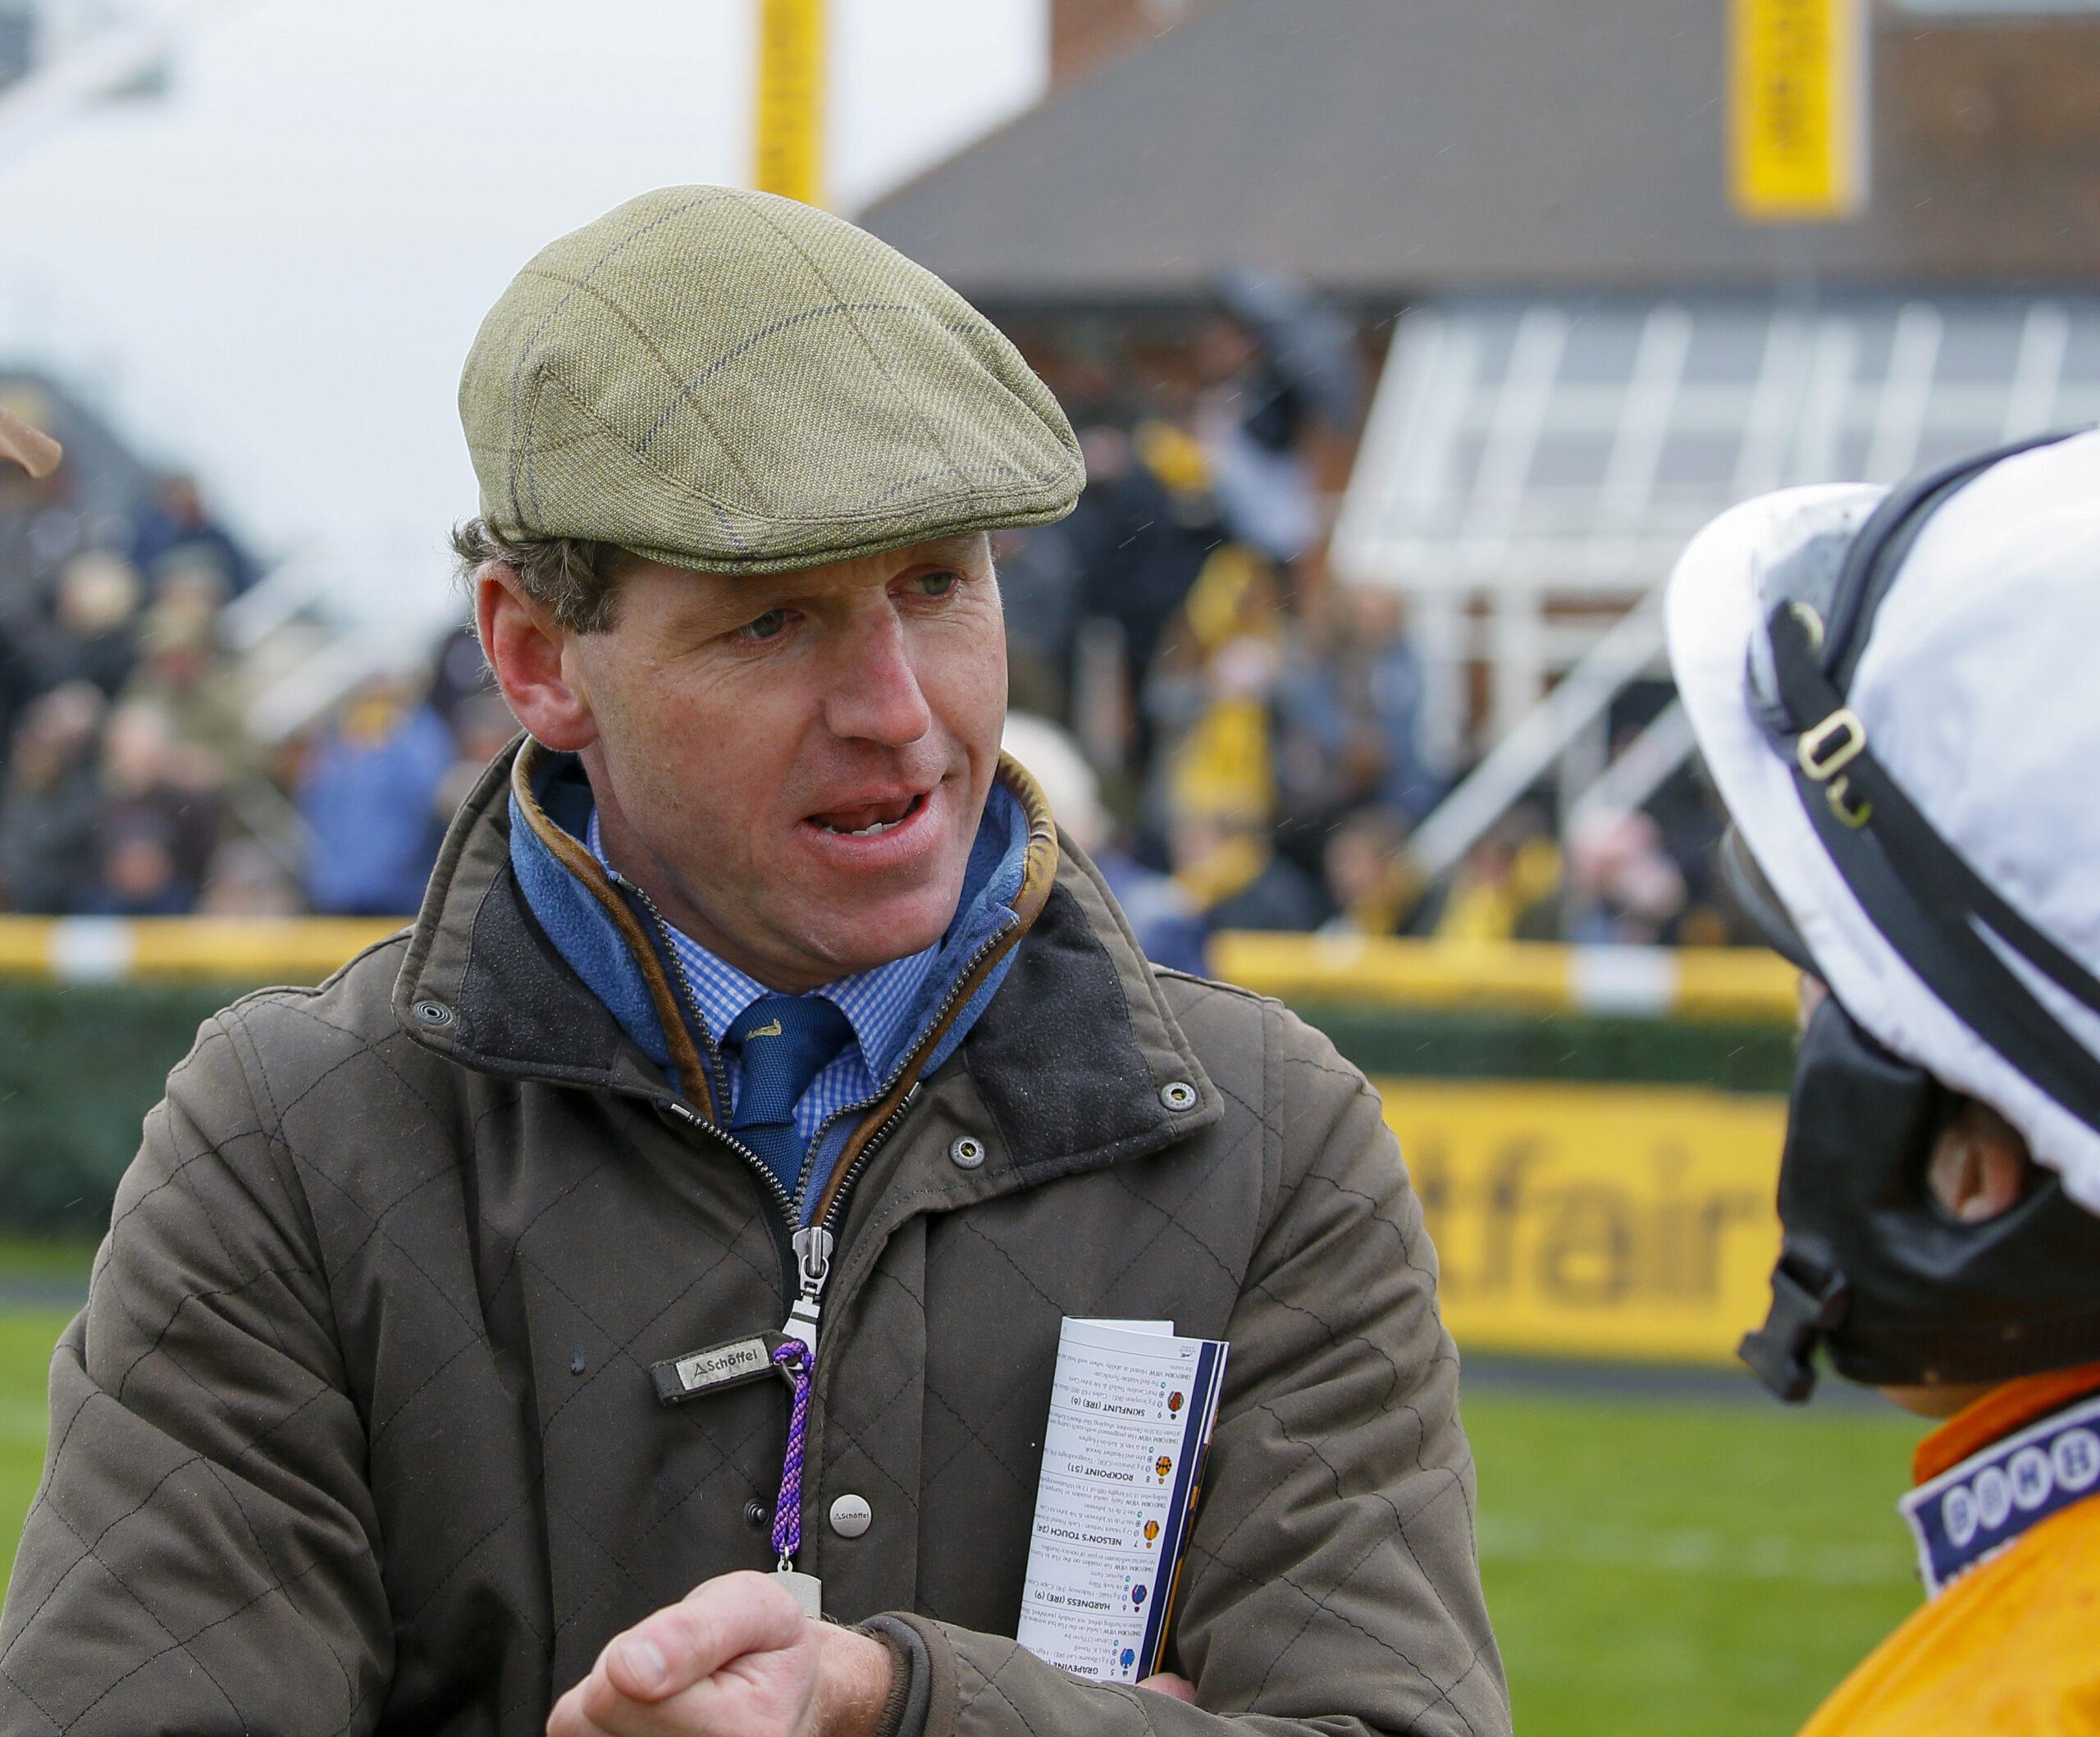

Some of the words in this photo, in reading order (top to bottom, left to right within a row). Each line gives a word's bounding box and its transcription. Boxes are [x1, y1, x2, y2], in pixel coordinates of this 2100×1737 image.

[707, 1348, 758, 1372] Schöffel
[1106, 1362, 1122, 1371] ability
[1130, 1366, 1148, 1375] Hinted
[1093, 1371, 1120, 1381] Syndicate
[1164, 1371, 1190, 1380] TIMEFORM
[1080, 1378, 1093, 1387] John
[1071, 1396, 1081, 1406] (6)
[1082, 1398, 1101, 1409] (IRE)
[1102, 1404, 1144, 1416] SKINFLINT
[1093, 1419, 1114, 1429] shaping
[1097, 1428, 1126, 1438] progressed
[1102, 1450, 1124, 1459] Heather
[1066, 1462, 1083, 1473] (51)
[1084, 1468, 1133, 1481] ROCKPOINT
[1084, 1503, 1106, 1512] Johnson
[1049, 1516, 1066, 1525] Friend
[1084, 1513, 1106, 1522] Johnson
[1036, 1522, 1049, 1533] (24)
[1066, 1519, 1080, 1528] Lady
[1084, 1523, 1104, 1532] Nelson
[1050, 1528, 1079, 1539] TOUCH
[1104, 1526, 1121, 1534] Mount
[1082, 1534, 1121, 1545] NELSON'S
[1034, 1589, 1045, 1600] (9)
[1046, 1593, 1065, 1603] (IRE)
[1066, 1598, 1110, 1610] HARDNESS
[1057, 1613, 1076, 1621] unduly
[1057, 1621, 1067, 1630] Flat
[1052, 1662, 1098, 1674] GRAPEVINE
[1110, 1668, 1115, 1676] 5
